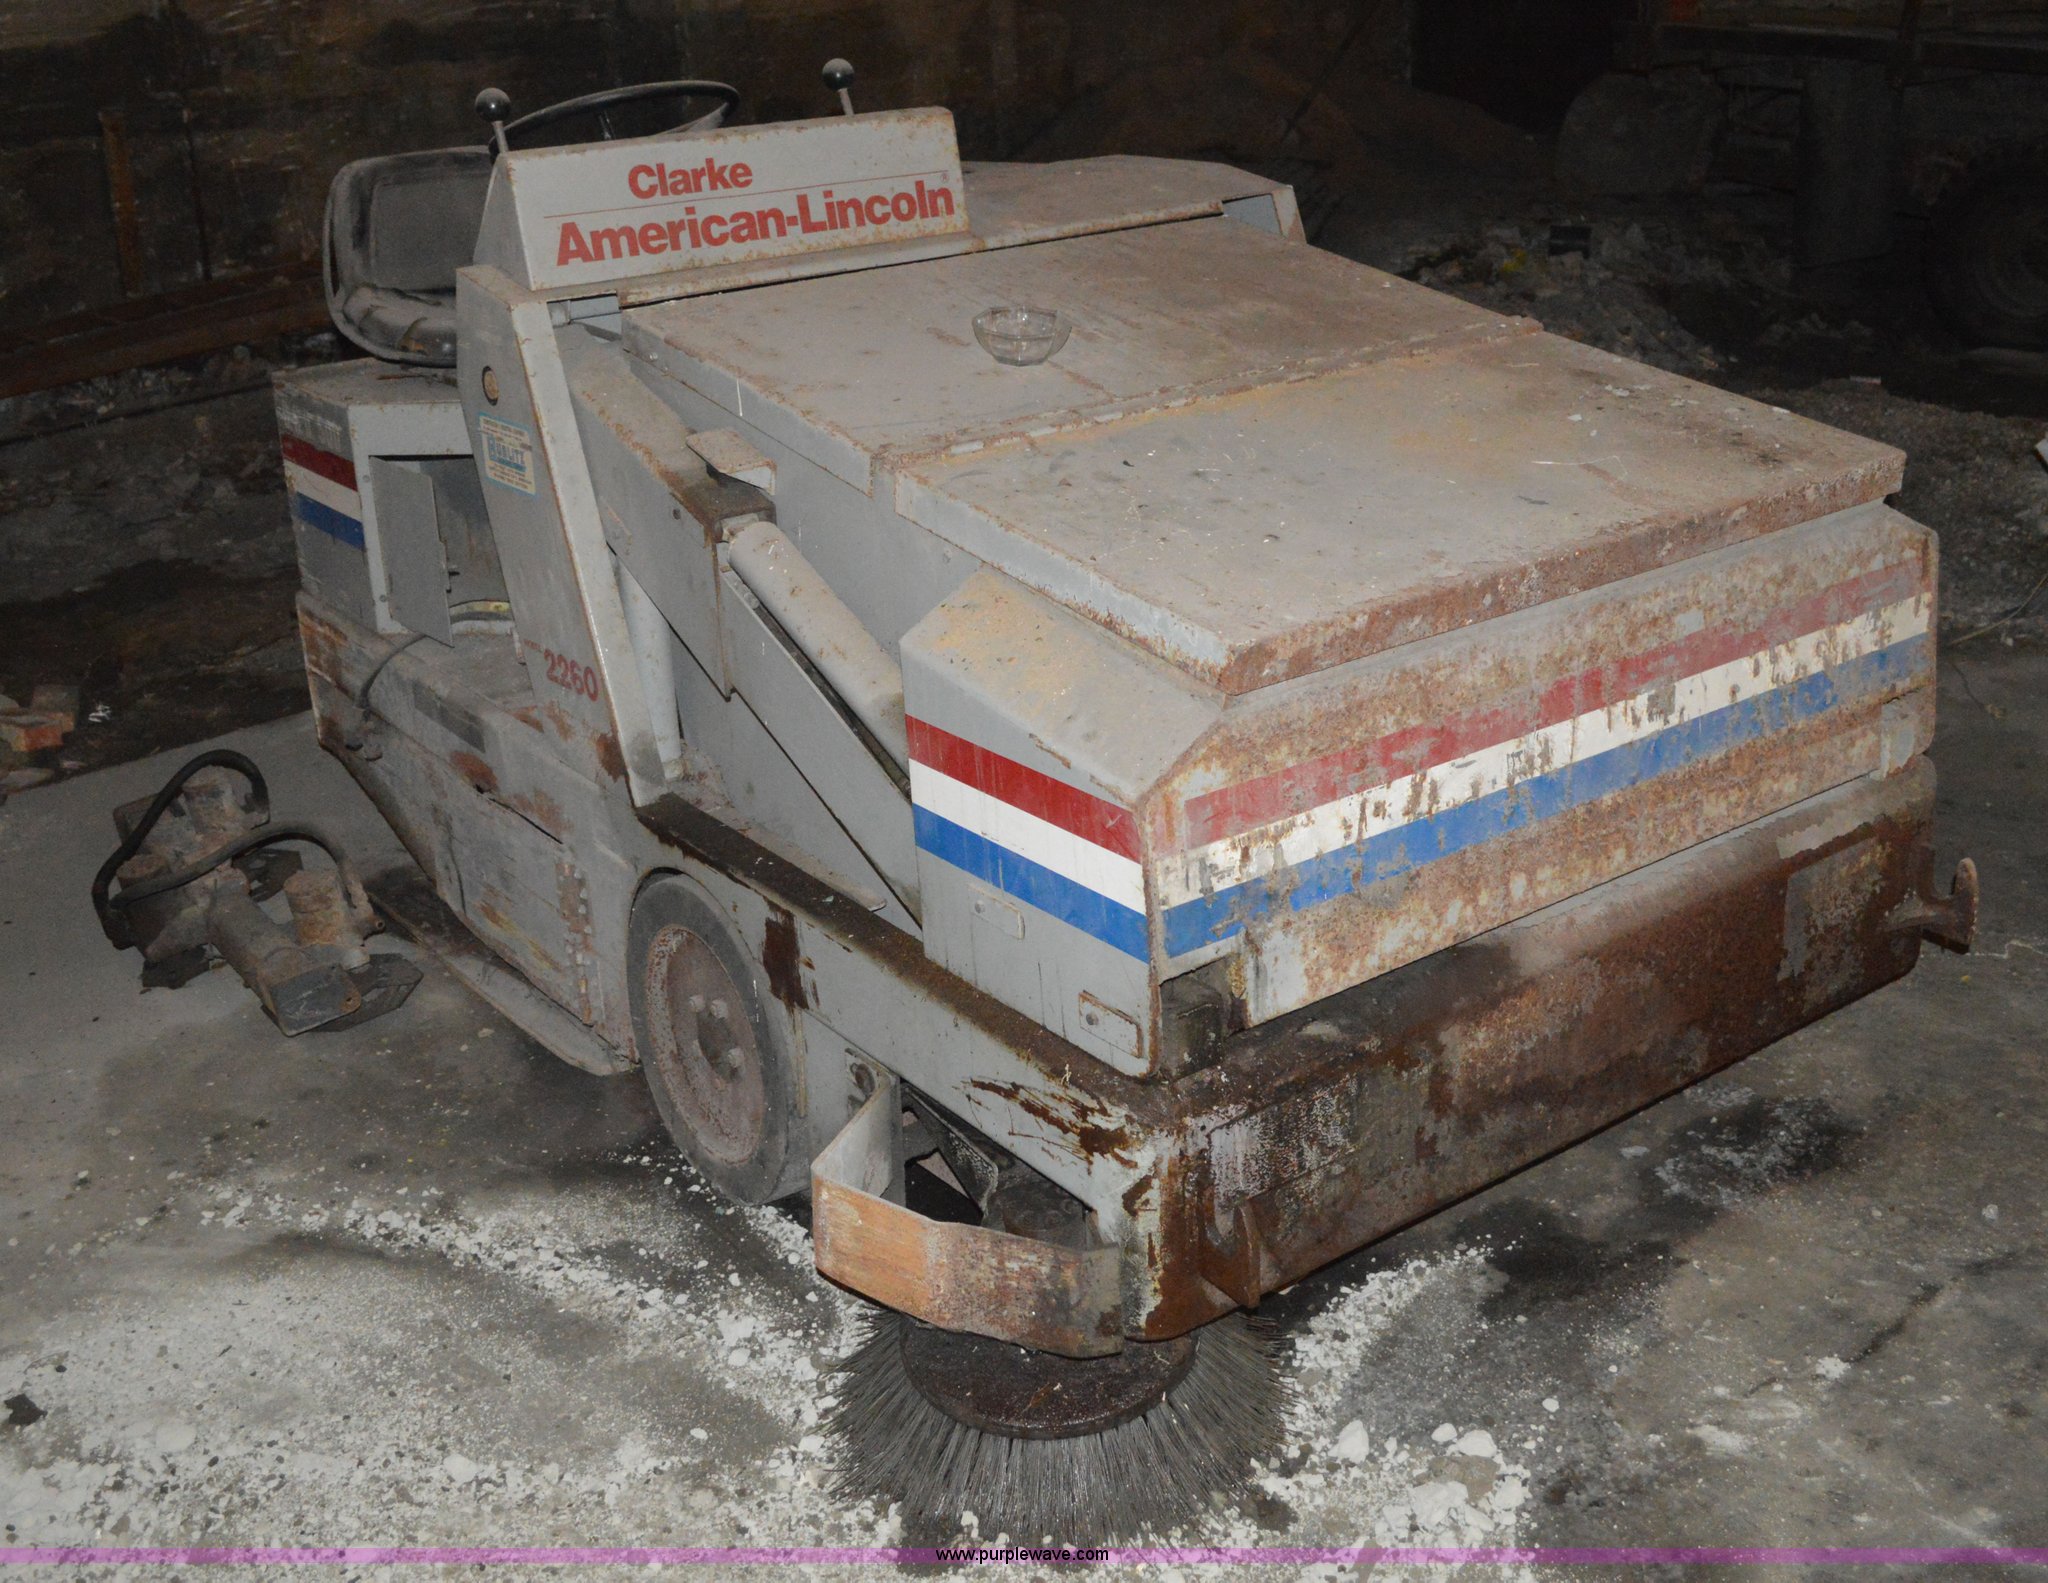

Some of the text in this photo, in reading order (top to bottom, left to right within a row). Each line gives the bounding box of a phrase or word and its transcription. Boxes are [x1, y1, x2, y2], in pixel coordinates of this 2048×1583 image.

[628, 157, 753, 199] Clarke
[557, 179, 955, 266] American-Lincoln
[543, 647, 599, 701] 2260
